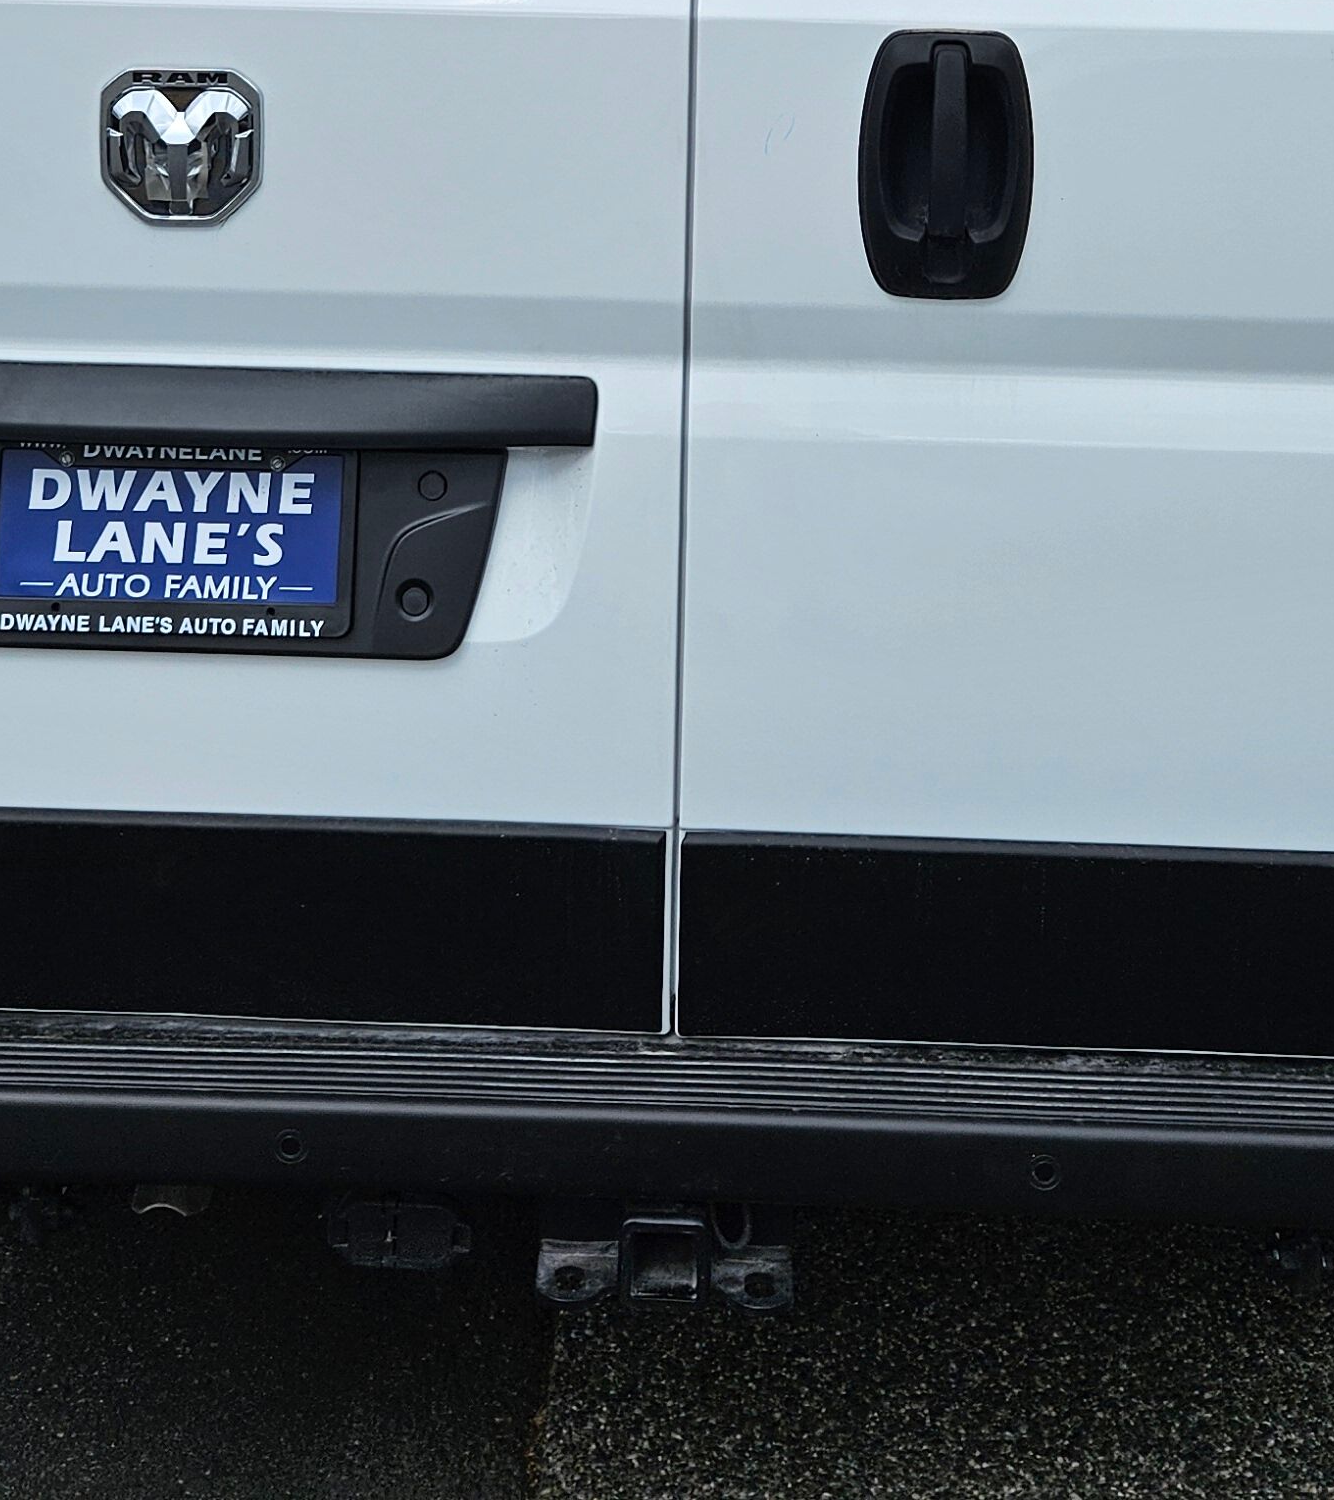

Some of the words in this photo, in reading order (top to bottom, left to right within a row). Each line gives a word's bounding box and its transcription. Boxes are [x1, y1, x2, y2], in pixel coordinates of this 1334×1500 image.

[132, 72, 229, 85] RAM
[28, 468, 315, 515] DWAYNE
[53, 520, 284, 566] LANE'S
[55, 573, 150, 598] AUTO
[164, 575, 278, 600] FAMILY
[0, 613, 91, 633] DWAYNE
[98, 616, 173, 634] LANE'S
[179, 617, 237, 636] AUTO
[242, 618, 325, 638] FAMILY
